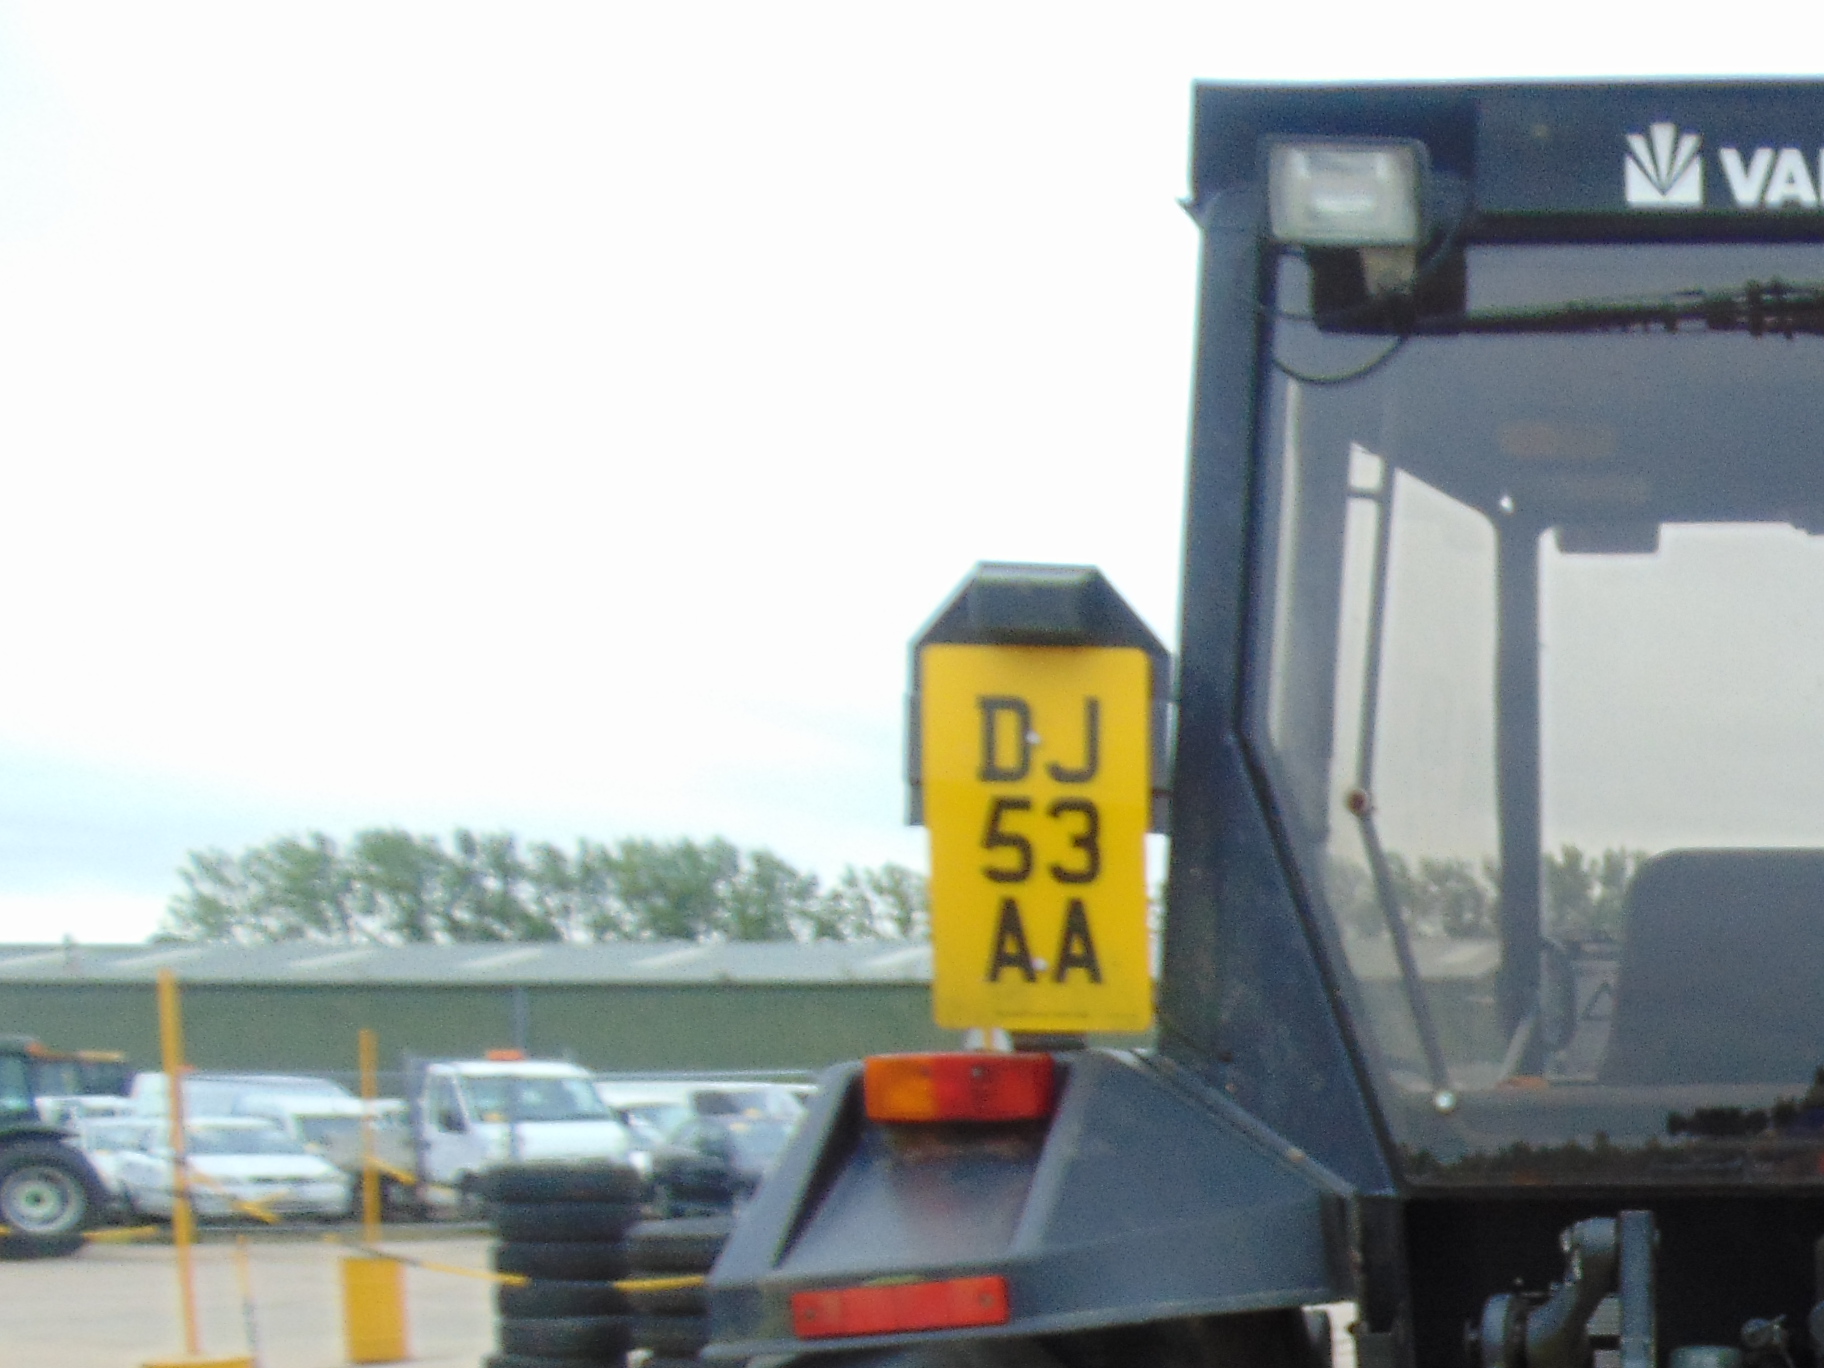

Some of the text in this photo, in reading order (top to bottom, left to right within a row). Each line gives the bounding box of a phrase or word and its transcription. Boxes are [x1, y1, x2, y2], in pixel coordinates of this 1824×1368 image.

[976, 694, 1102, 784] DJ
[980, 795, 1102, 884] 53
[985, 897, 1103, 985] AA
